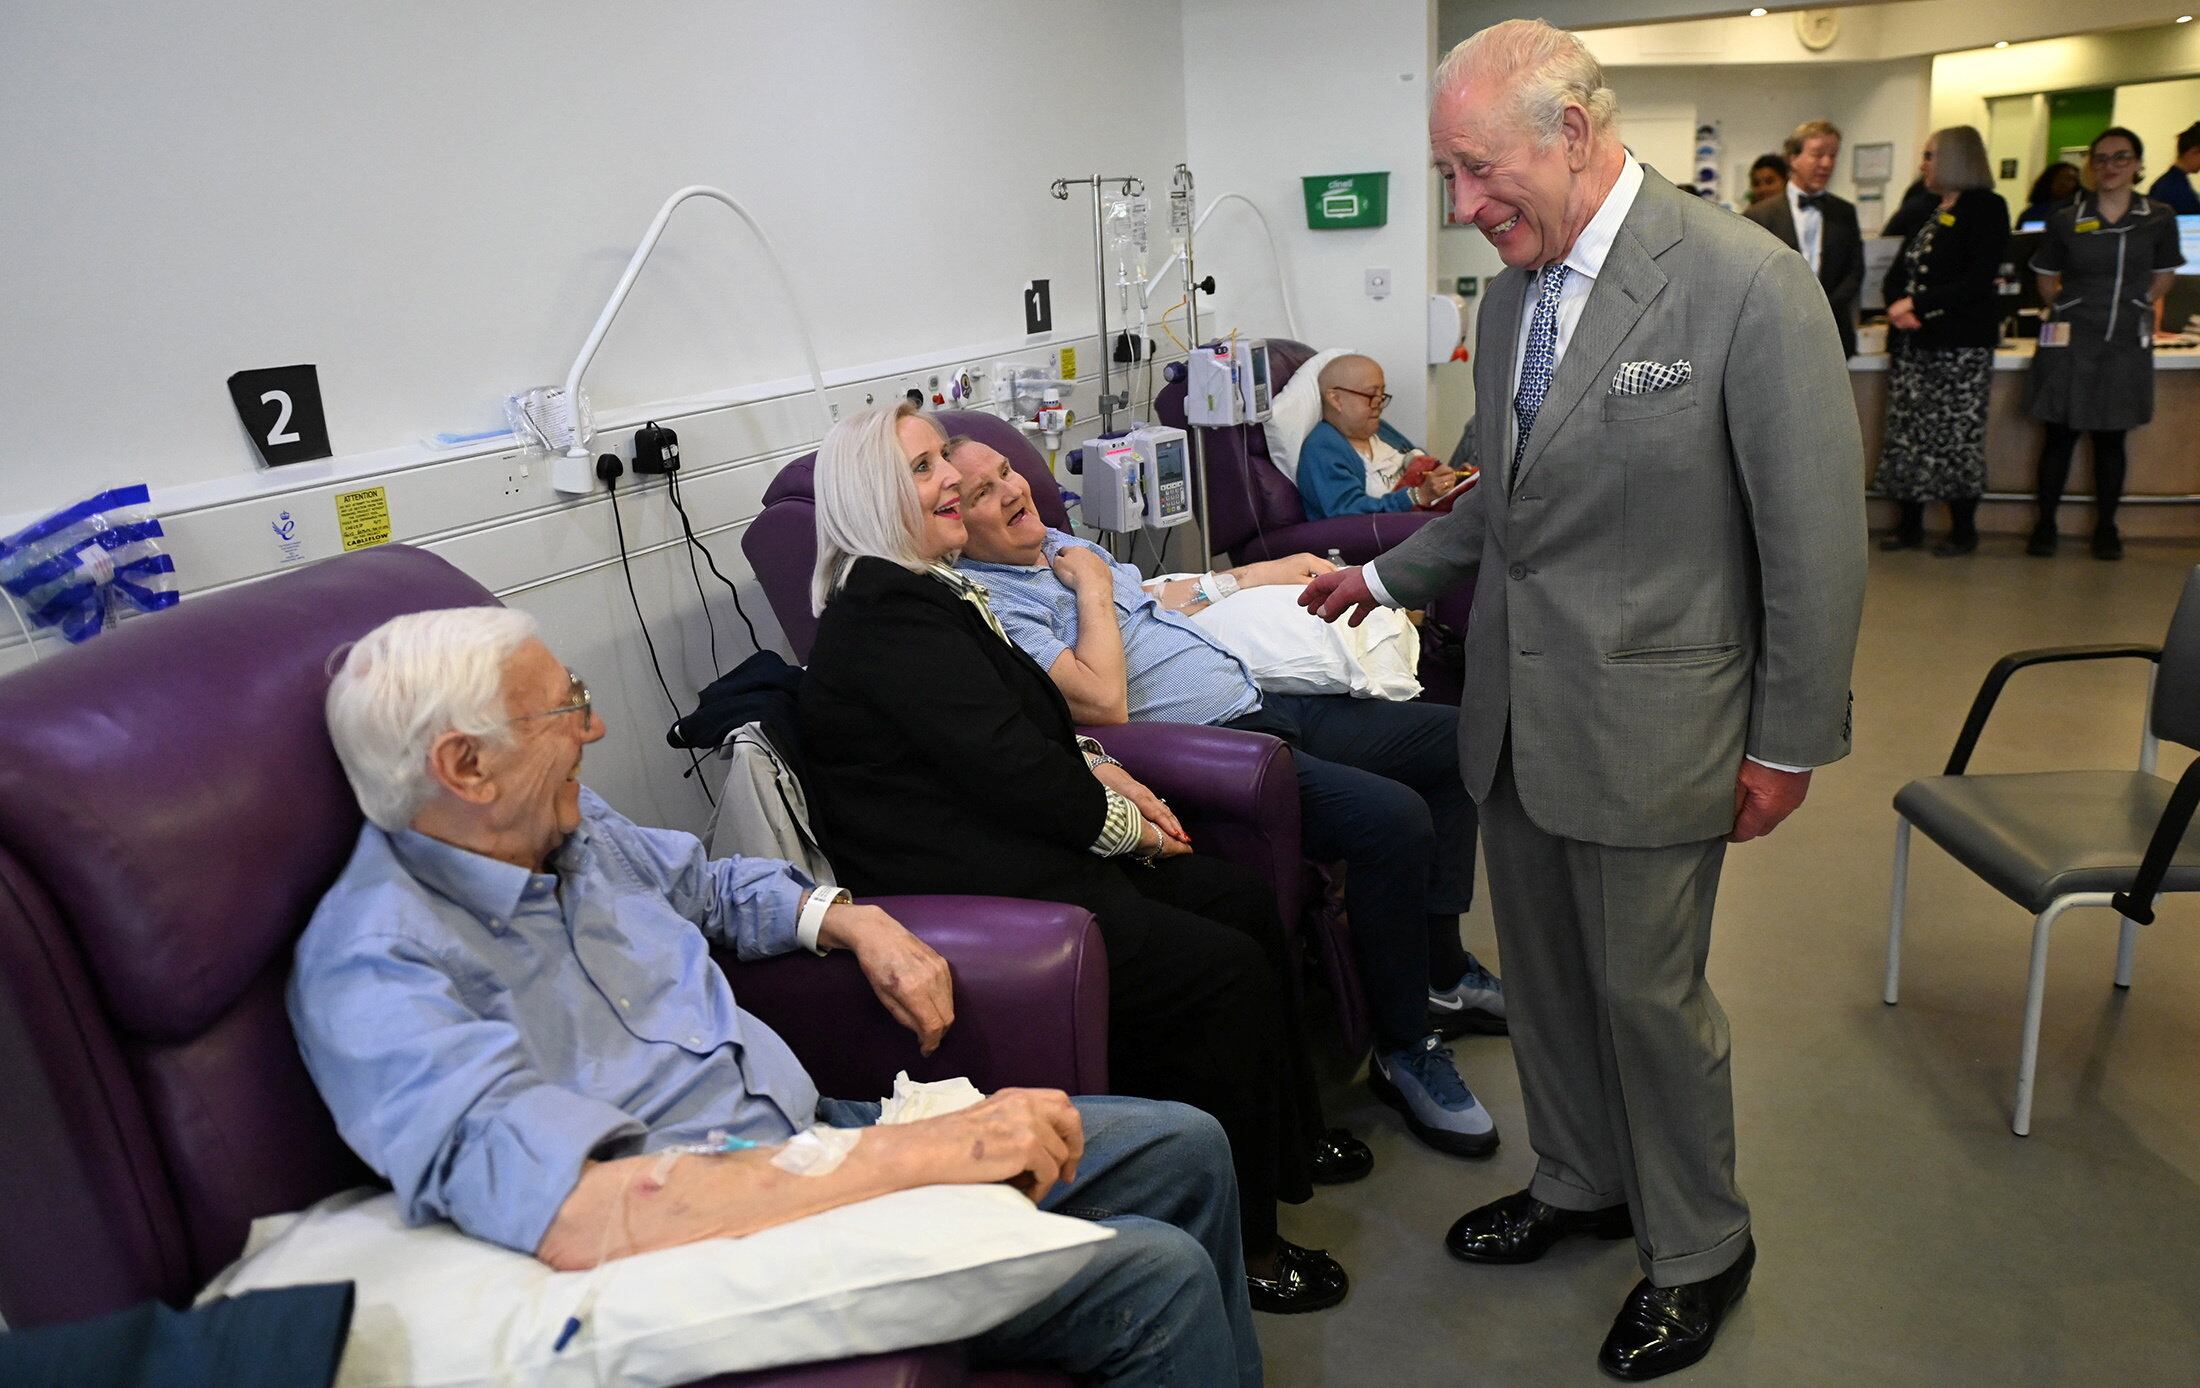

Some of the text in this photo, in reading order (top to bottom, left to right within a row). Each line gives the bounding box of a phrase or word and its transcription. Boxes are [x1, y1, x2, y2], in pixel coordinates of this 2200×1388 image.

[1032, 292, 1042, 322] 1
[260, 389, 301, 446] 2
[343, 490, 378, 503] ATTENTION
